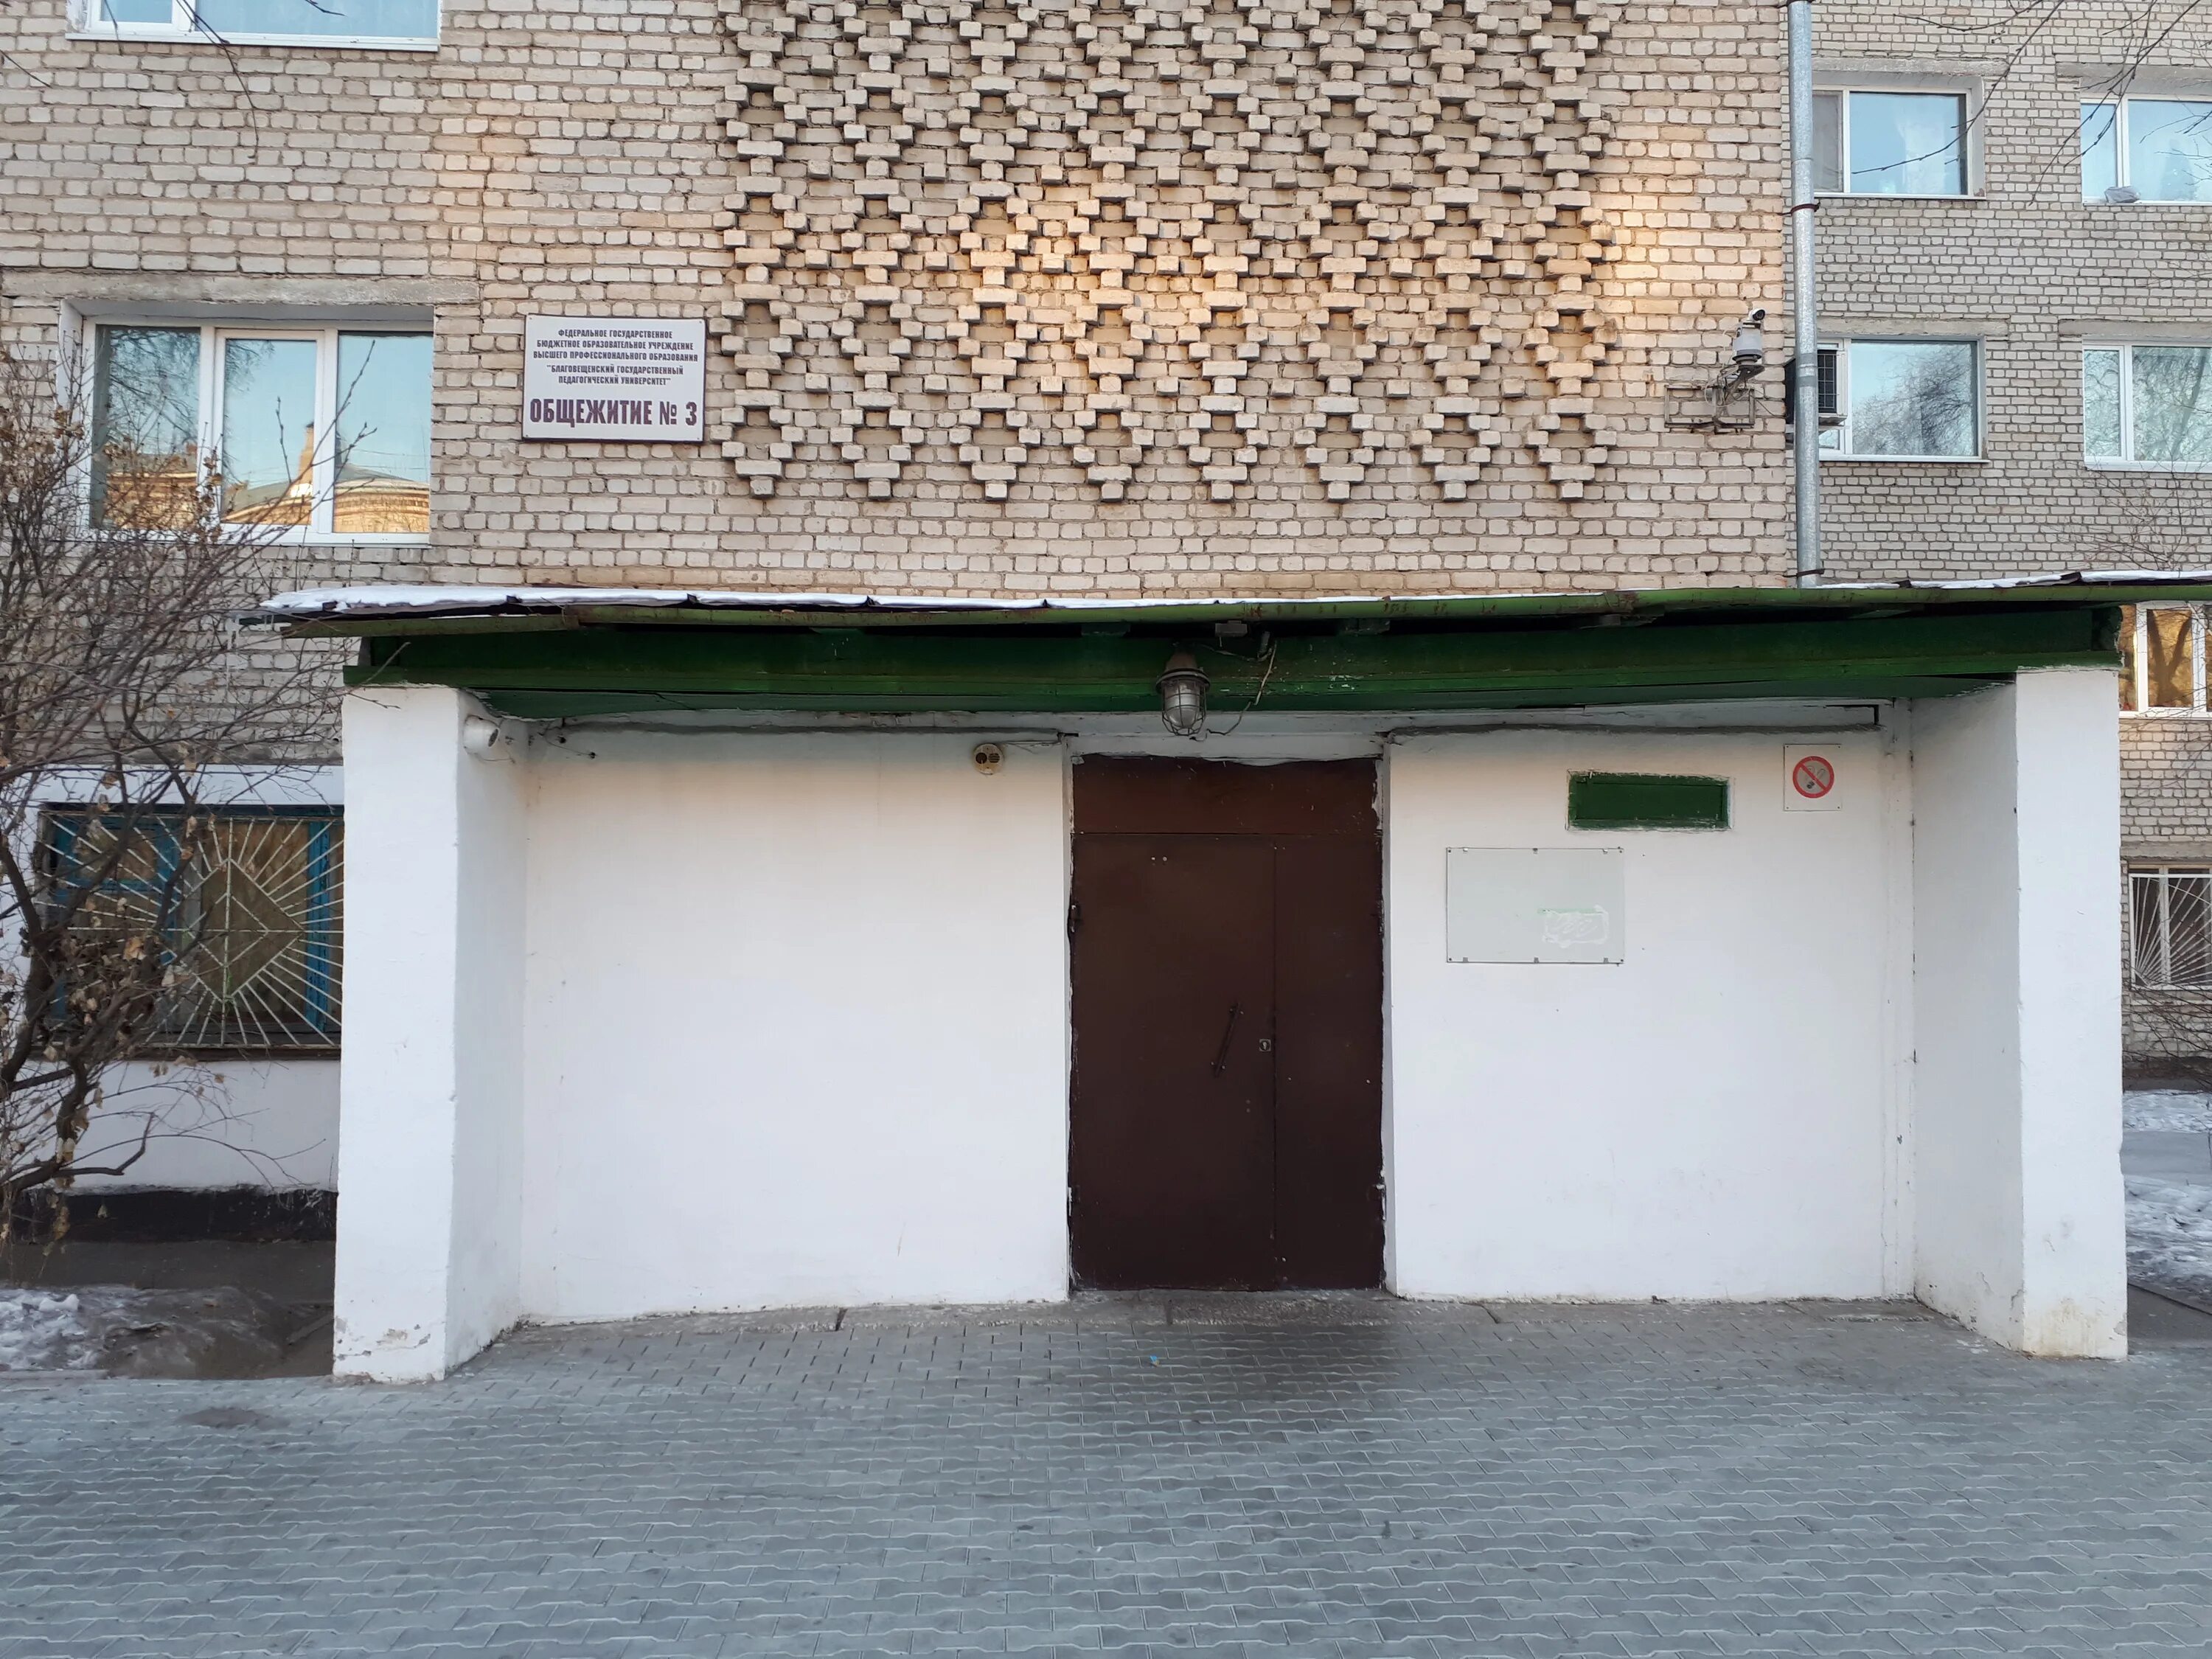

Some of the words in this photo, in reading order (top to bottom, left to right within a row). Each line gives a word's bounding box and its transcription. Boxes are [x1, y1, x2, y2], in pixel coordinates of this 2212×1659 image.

[558, 330, 607, 338] ФЕДЕРАЛЬНОЕ
[609, 330, 672, 338] ГОСУДАРСТВЕННОЕ
[537, 340, 580, 349] БЮДЖЕТНОЕ
[648, 342, 693, 350] УЧРЕЖДЕНИЕ
[533, 351, 568, 359] ВЫСШЕГО
[649, 353, 698, 361] ОБРАЗОВАНИЯ
[547, 364, 615, 374] "БЛАГОВЕЩЕНСКИЙ
[617, 366, 684, 375] ГОСУДАРСТВЕННЫЙ
[559, 375, 619, 384] ПЕДАГОГИЧЕСКИЙ
[530, 399, 653, 428] ОБЩЕЖИТИЕ
[660, 401, 677, 425] №
[686, 402, 698, 426] 3
